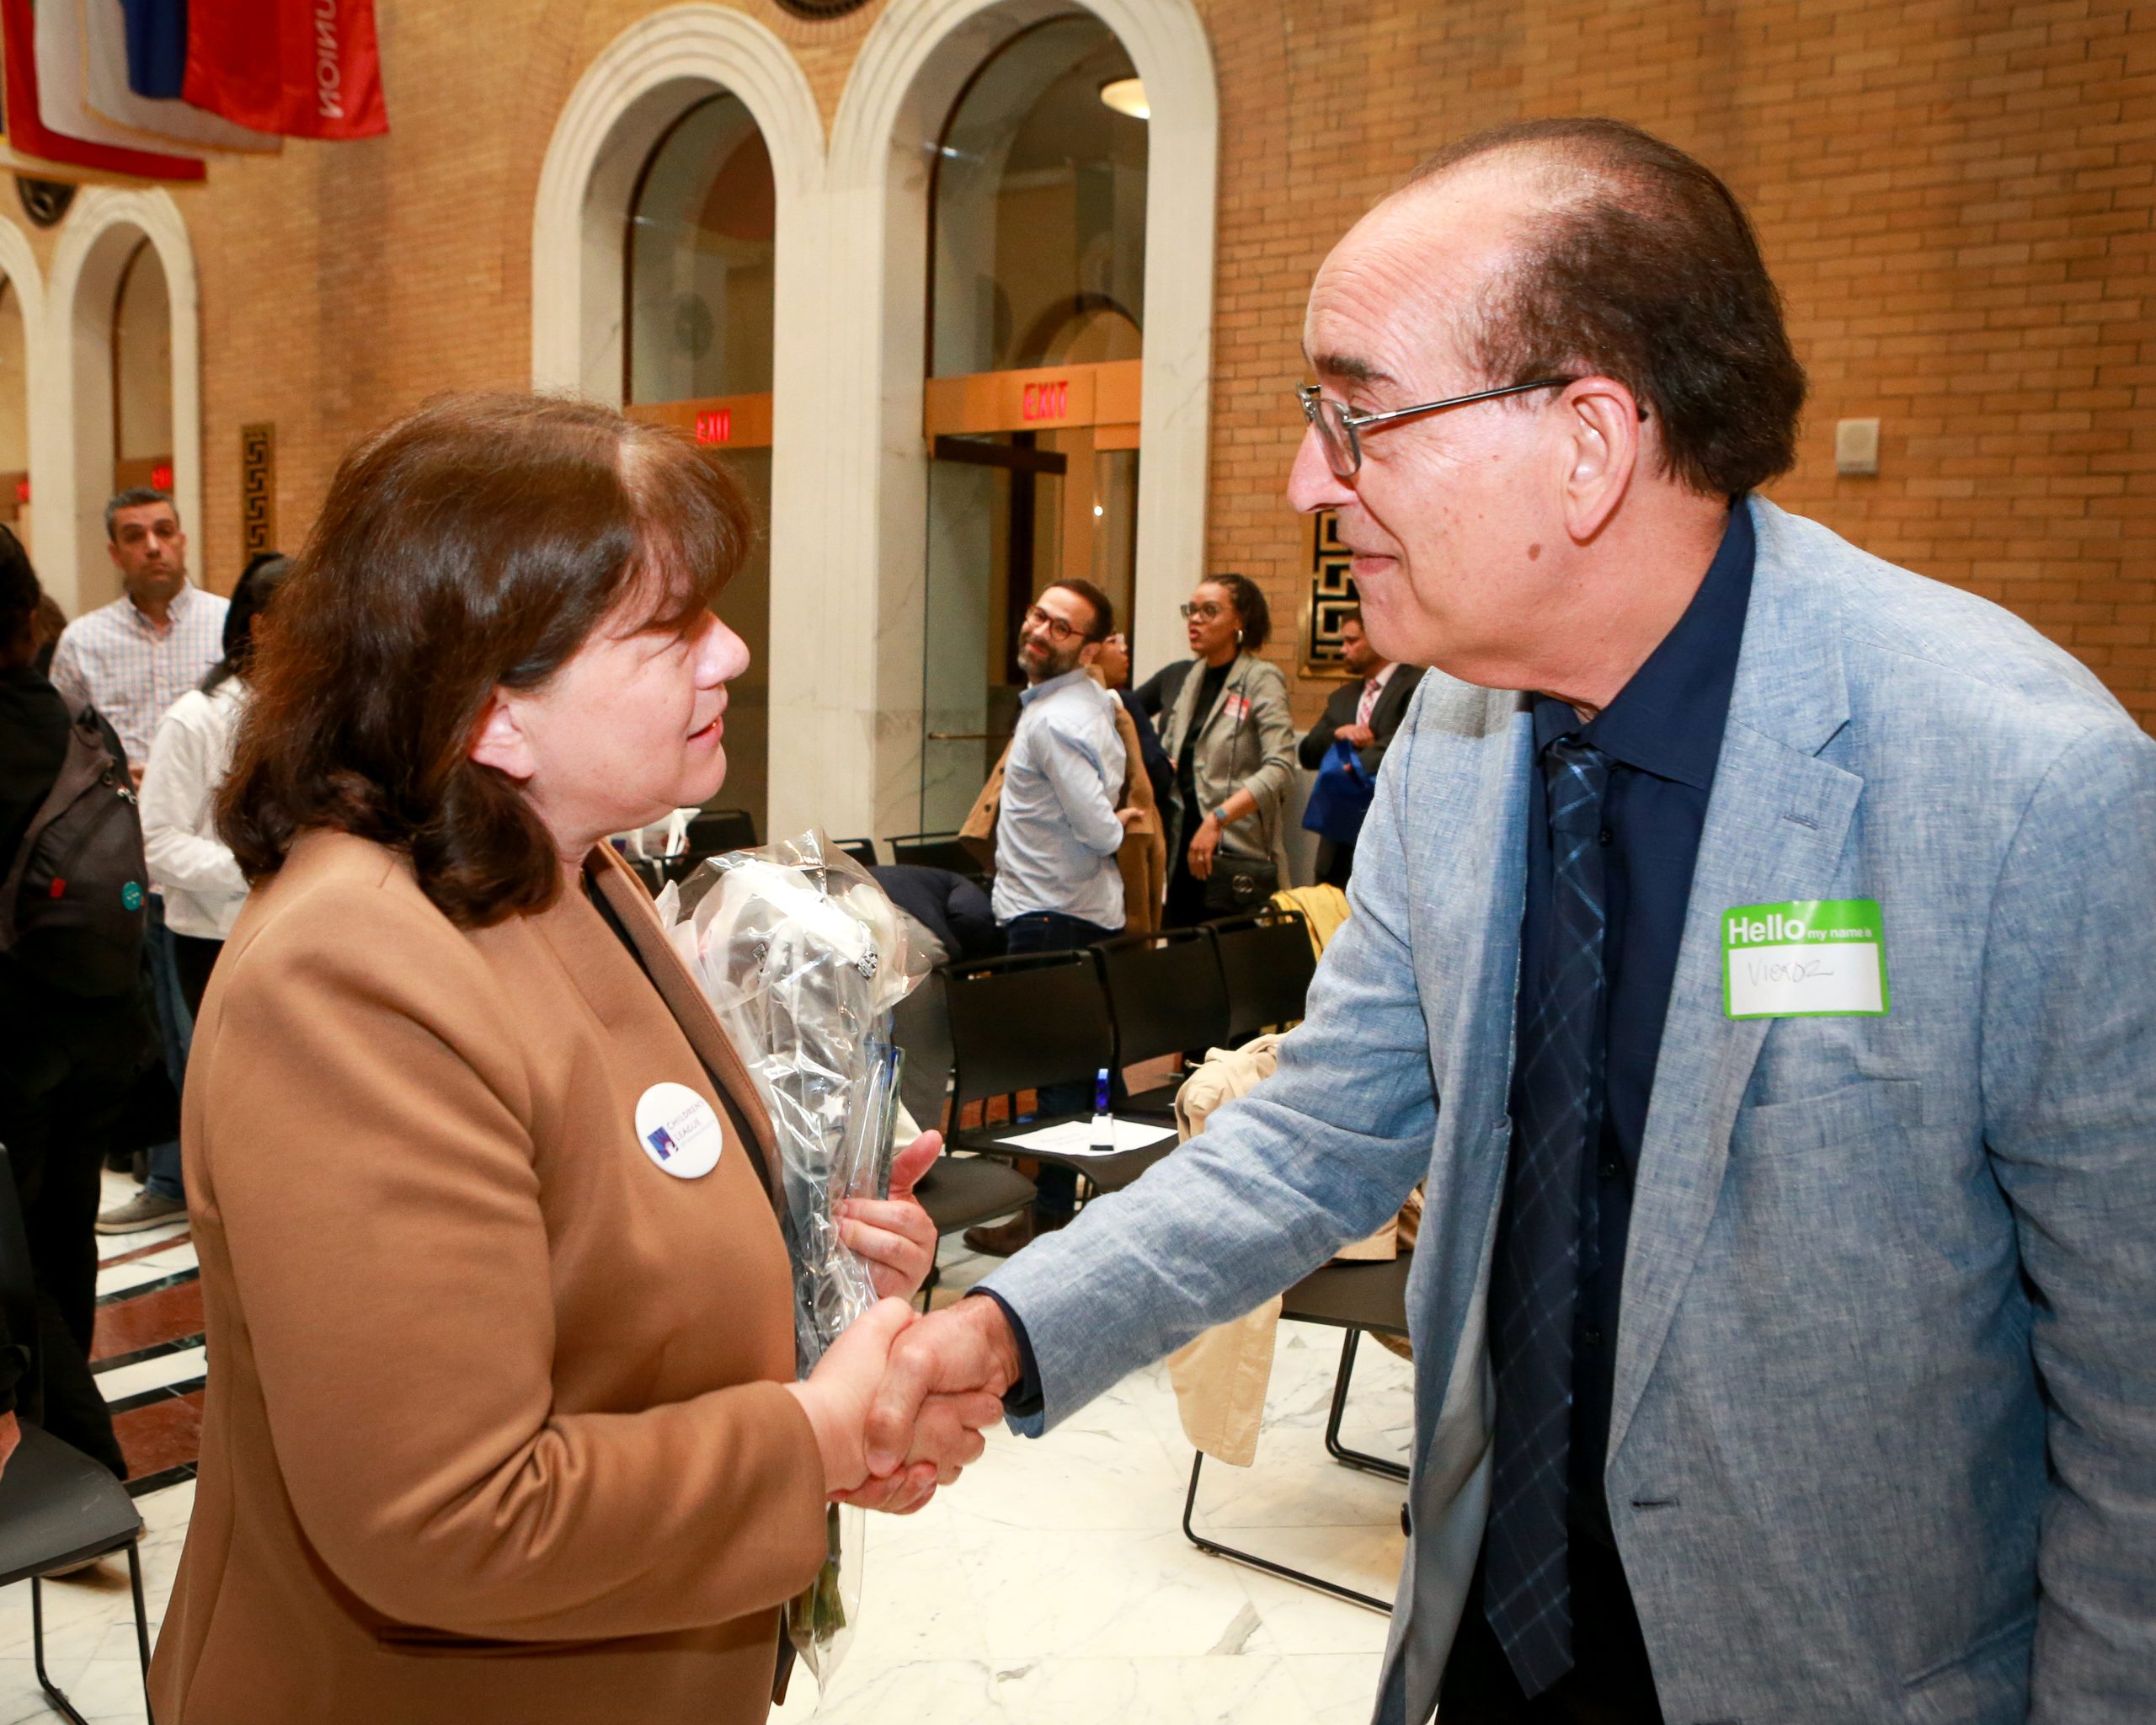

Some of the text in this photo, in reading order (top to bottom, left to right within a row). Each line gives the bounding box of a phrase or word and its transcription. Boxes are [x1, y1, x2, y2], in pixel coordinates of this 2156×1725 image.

[1024, 381, 1069, 420] EXIT
[1729, 914, 1806, 944] Hello
[1807, 929, 1827, 942] my
[1829, 928, 1863, 938] name
